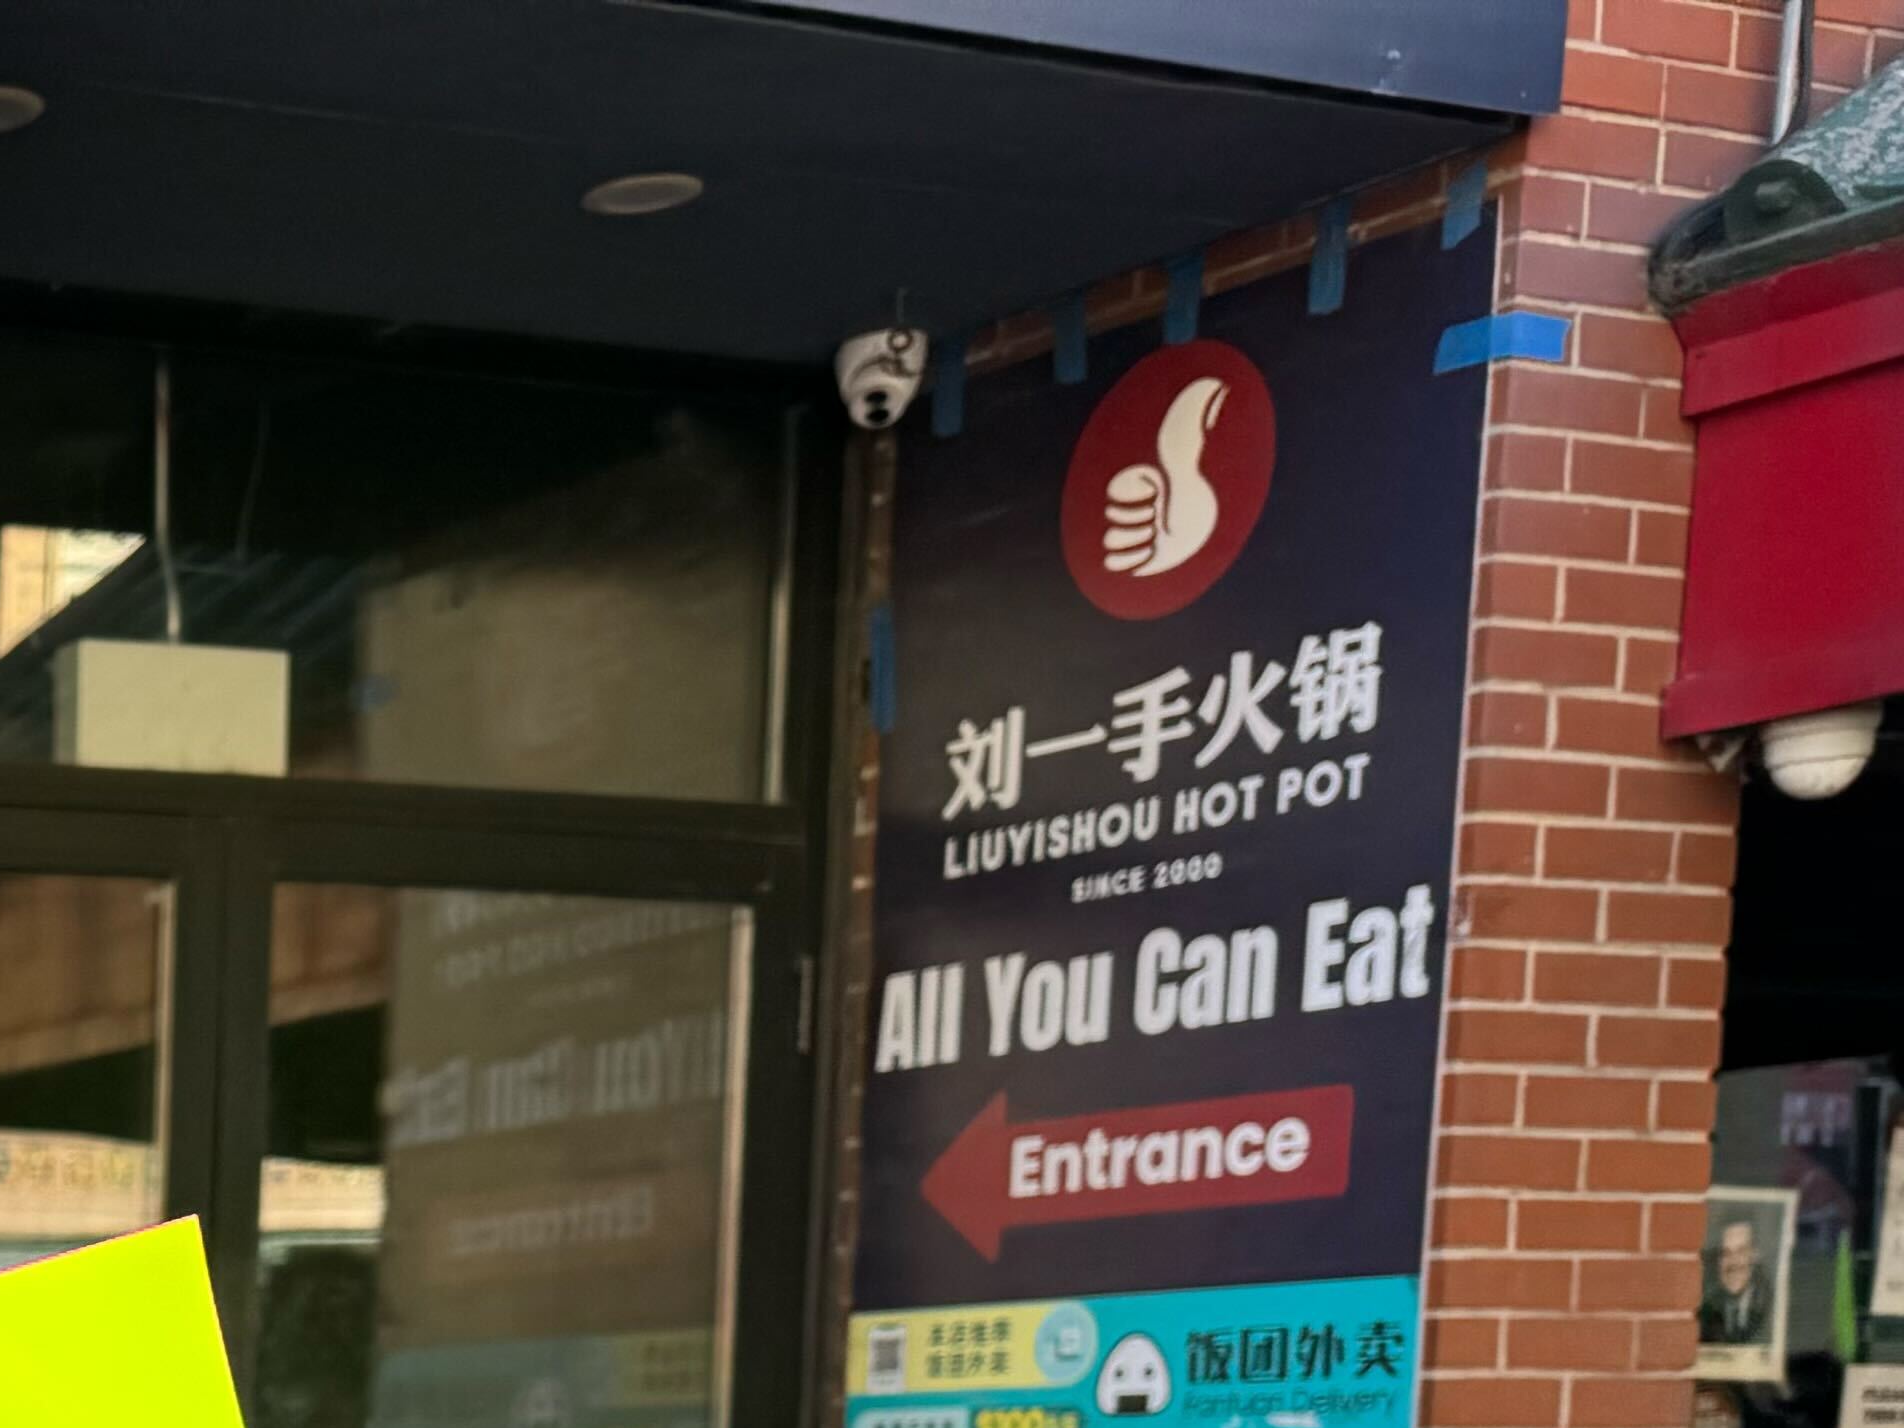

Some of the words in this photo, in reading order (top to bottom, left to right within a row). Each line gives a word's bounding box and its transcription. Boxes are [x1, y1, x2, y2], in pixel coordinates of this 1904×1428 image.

[941, 621, 1383, 821] 刘一手火锅
[943, 796, 1160, 880] LIUYISHOU
[1173, 774, 1264, 834] HOT
[1275, 753, 1370, 815] POT
[1072, 866, 1147, 903] SINCE
[874, 964, 965, 1073] All
[984, 952, 1113, 1057] You
[1134, 926, 1278, 1035] Can
[1301, 884, 1435, 1013] Eat
[1008, 1115, 1312, 1200] Entrance
[1185, 1320, 1404, 1385] 饭团外卖
